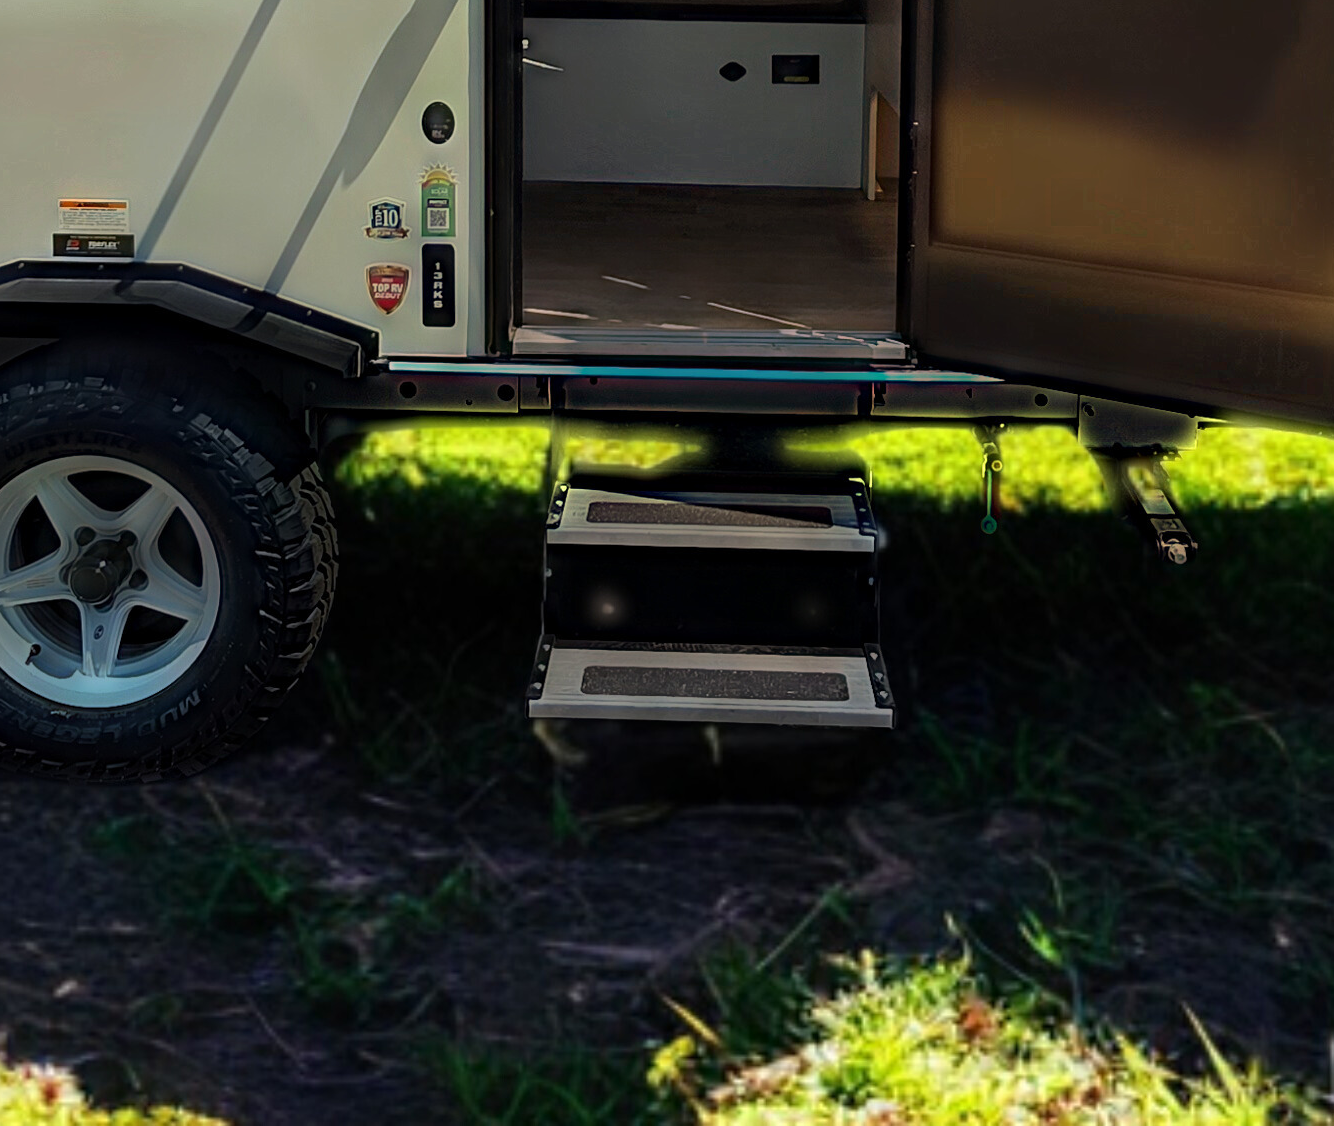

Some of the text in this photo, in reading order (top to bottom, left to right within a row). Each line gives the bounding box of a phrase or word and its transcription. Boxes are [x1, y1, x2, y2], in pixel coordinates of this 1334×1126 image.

[375, 209, 399, 227] TOP 10
[372, 283, 403, 293] TOP RV
[433, 261, 443, 309] 13RKS
[136, 688, 202, 737] MUD
